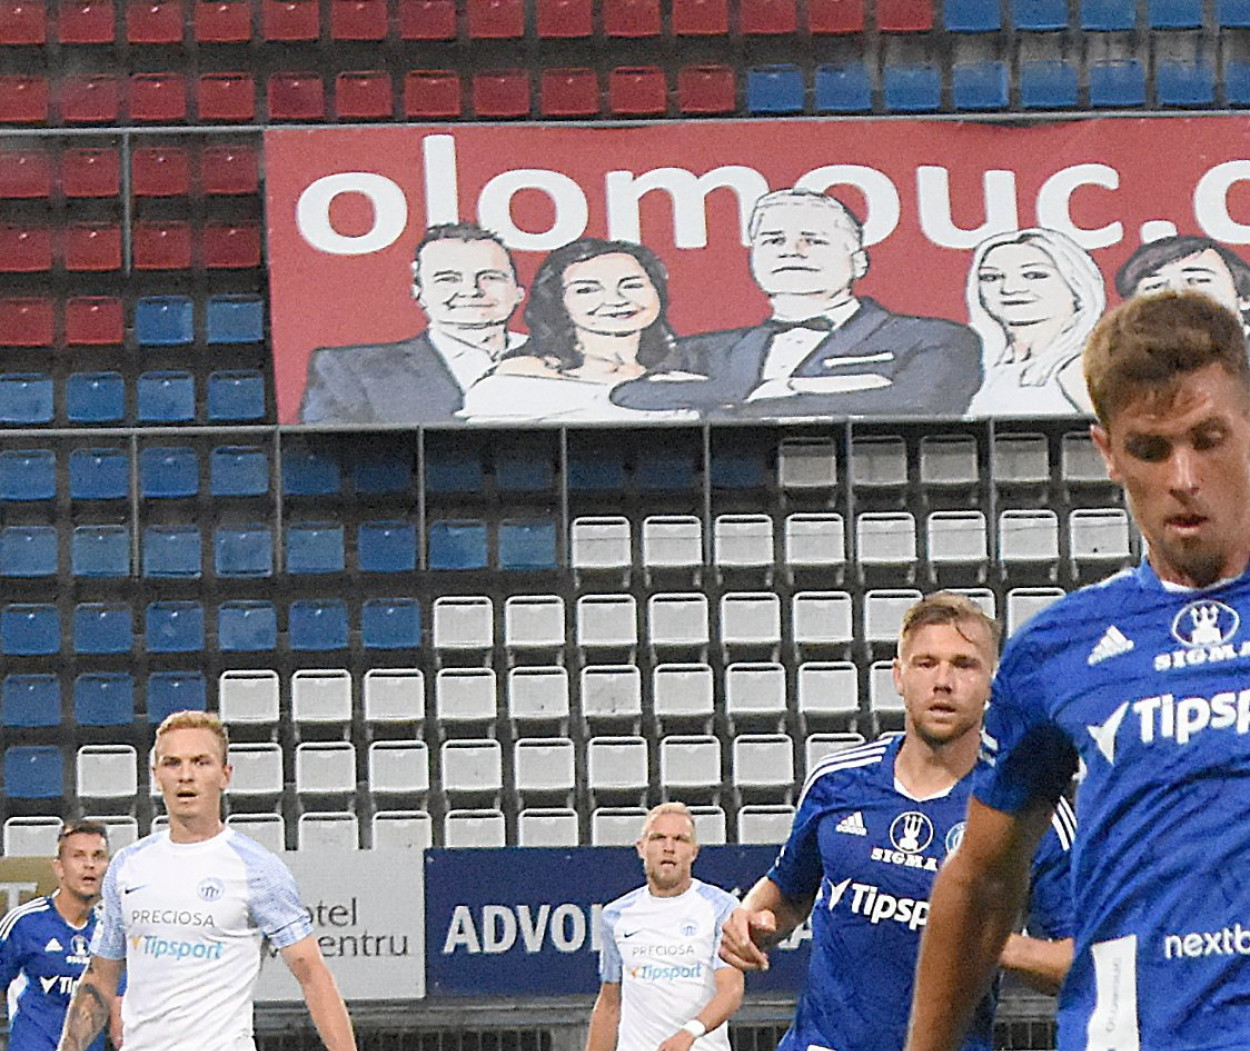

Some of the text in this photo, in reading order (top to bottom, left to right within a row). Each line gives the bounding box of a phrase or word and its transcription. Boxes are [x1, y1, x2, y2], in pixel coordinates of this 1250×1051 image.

[870, 848, 938, 871] SIGMA
[131, 910, 216, 928] PRECIOSA
[850, 883, 930, 930] Tipsp
[144, 935, 224, 960] Tipsport
[317, 929, 409, 957] entru
